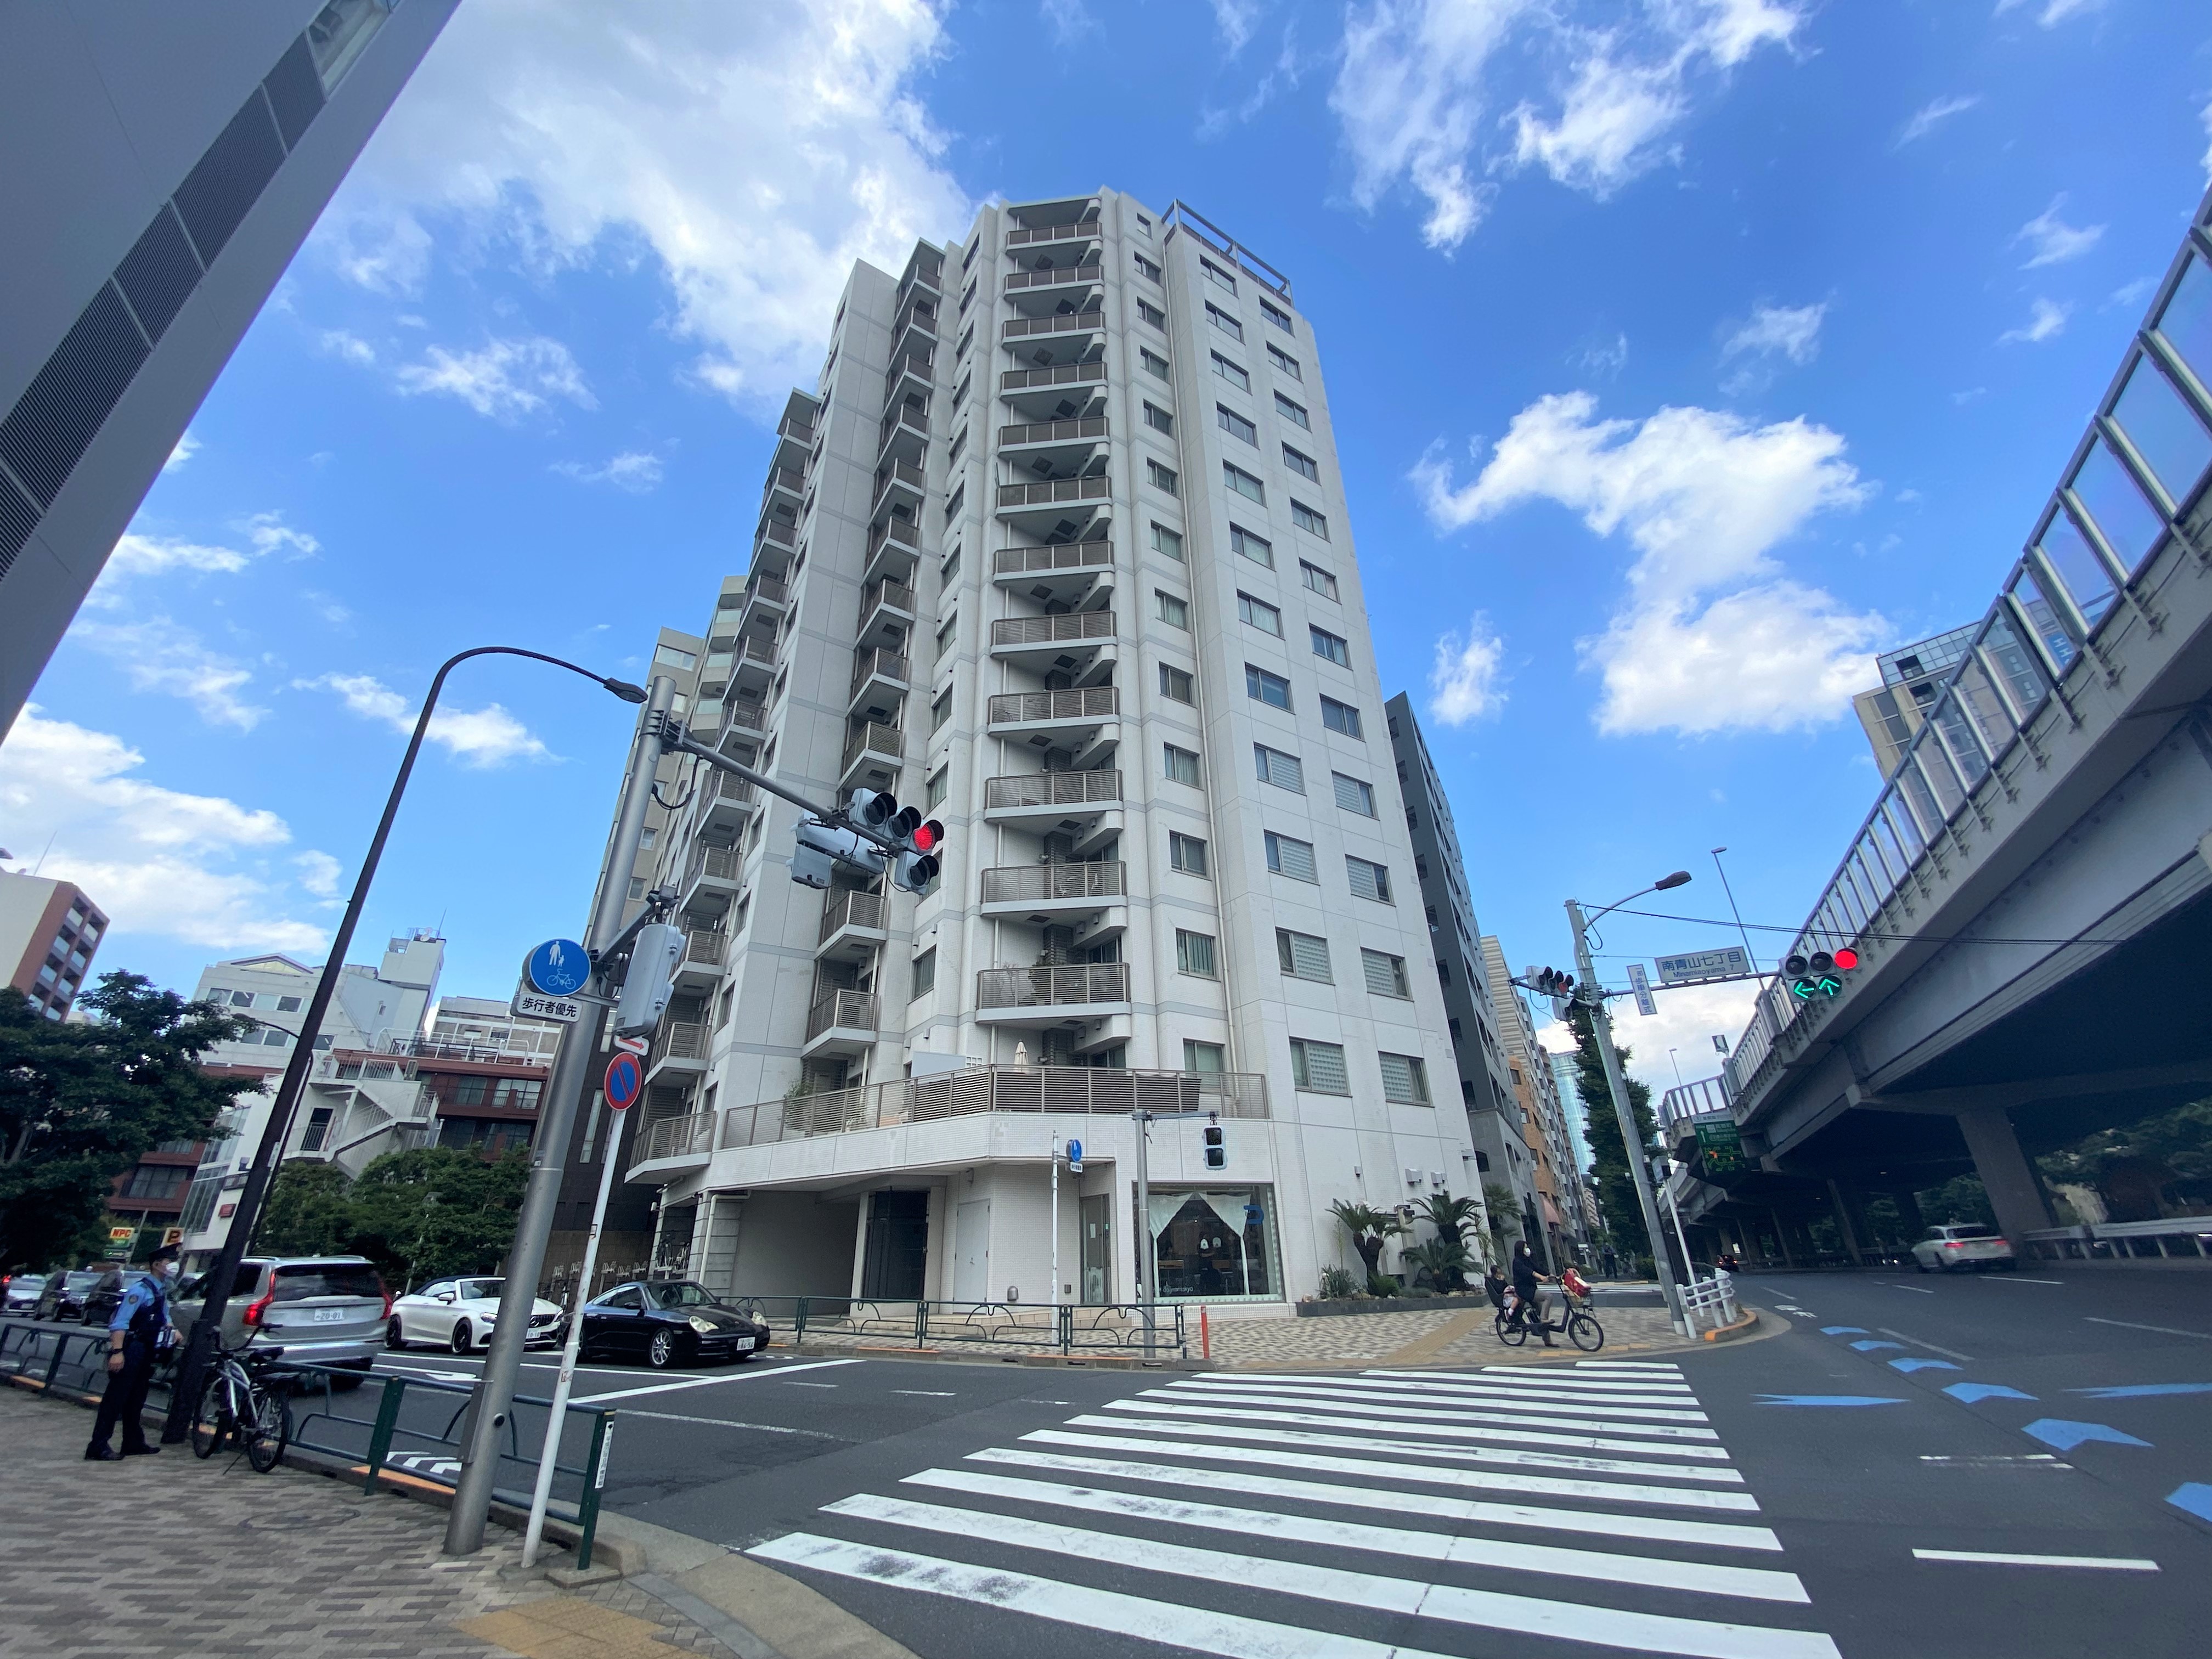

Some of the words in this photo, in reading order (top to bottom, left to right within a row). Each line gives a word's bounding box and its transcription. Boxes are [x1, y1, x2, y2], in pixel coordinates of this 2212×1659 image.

[1661, 951, 1741, 972] 南青山七丁目
[1673, 967, 1726, 978] Minamiaoyama
[522, 997, 577, 1017] 歩行者優先
[112, 1229, 131, 1237] NPC
[167, 1231, 180, 1242] P
